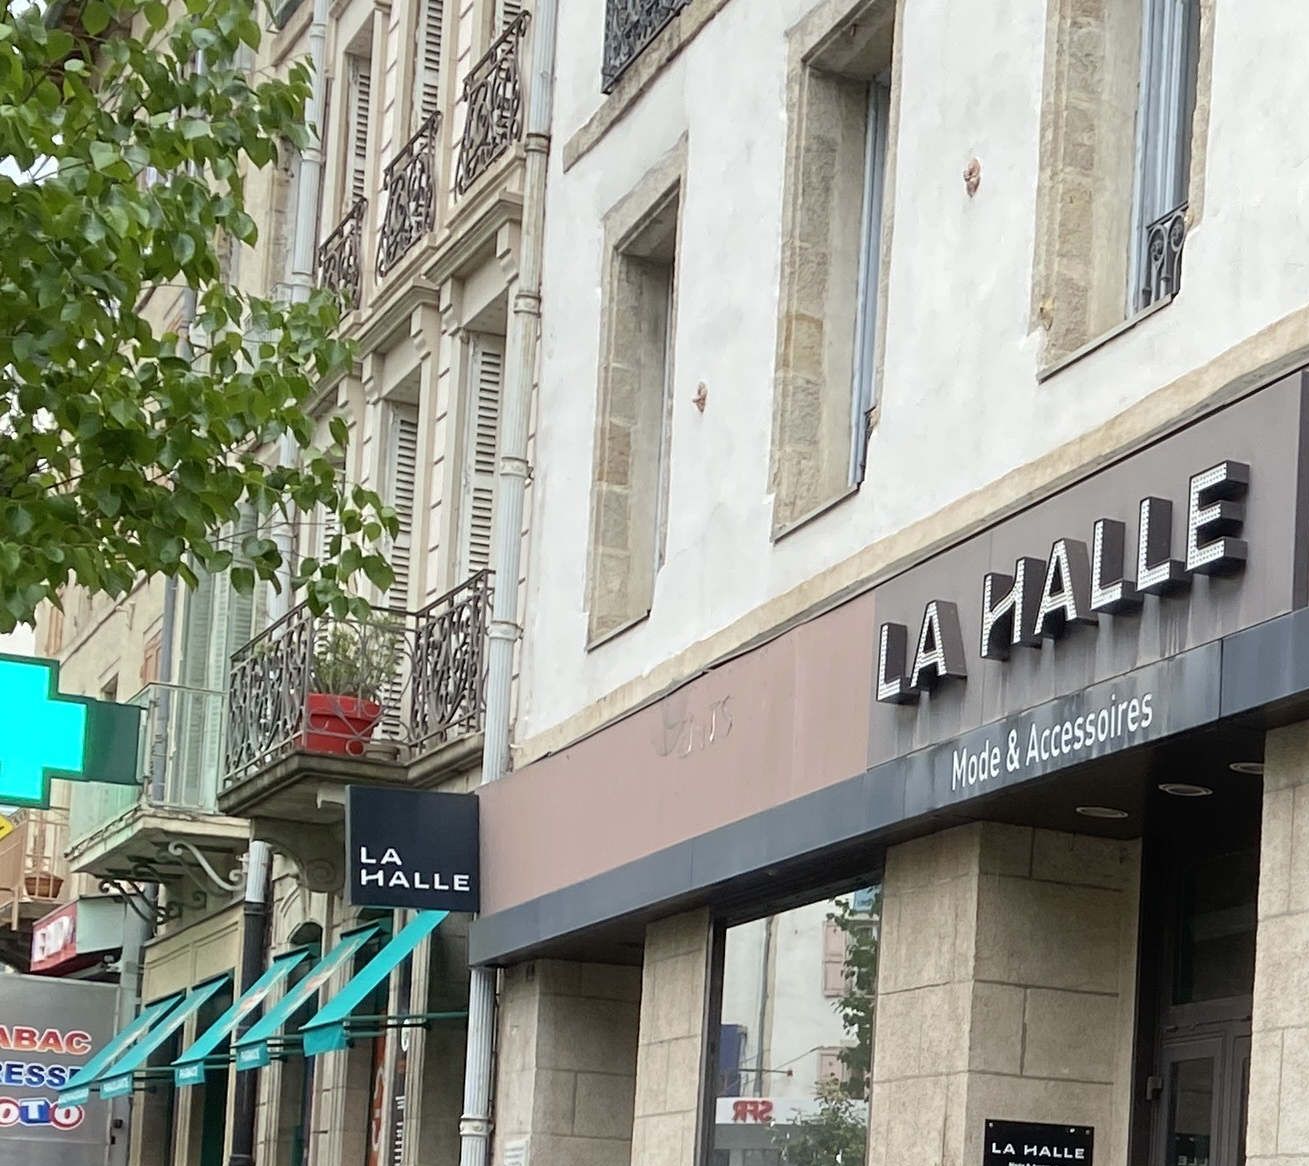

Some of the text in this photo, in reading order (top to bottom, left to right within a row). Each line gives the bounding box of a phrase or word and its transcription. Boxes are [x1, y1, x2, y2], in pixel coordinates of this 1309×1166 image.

[876, 460, 1250, 704] LA HALLE
[952, 692, 1153, 791] Mode & Accessoires
[360, 846, 402, 866] LA
[360, 868, 470, 892] HALLE
[0, 1061, 82, 1090] ESS
[992, 1142, 1085, 1159] LA HALLE
